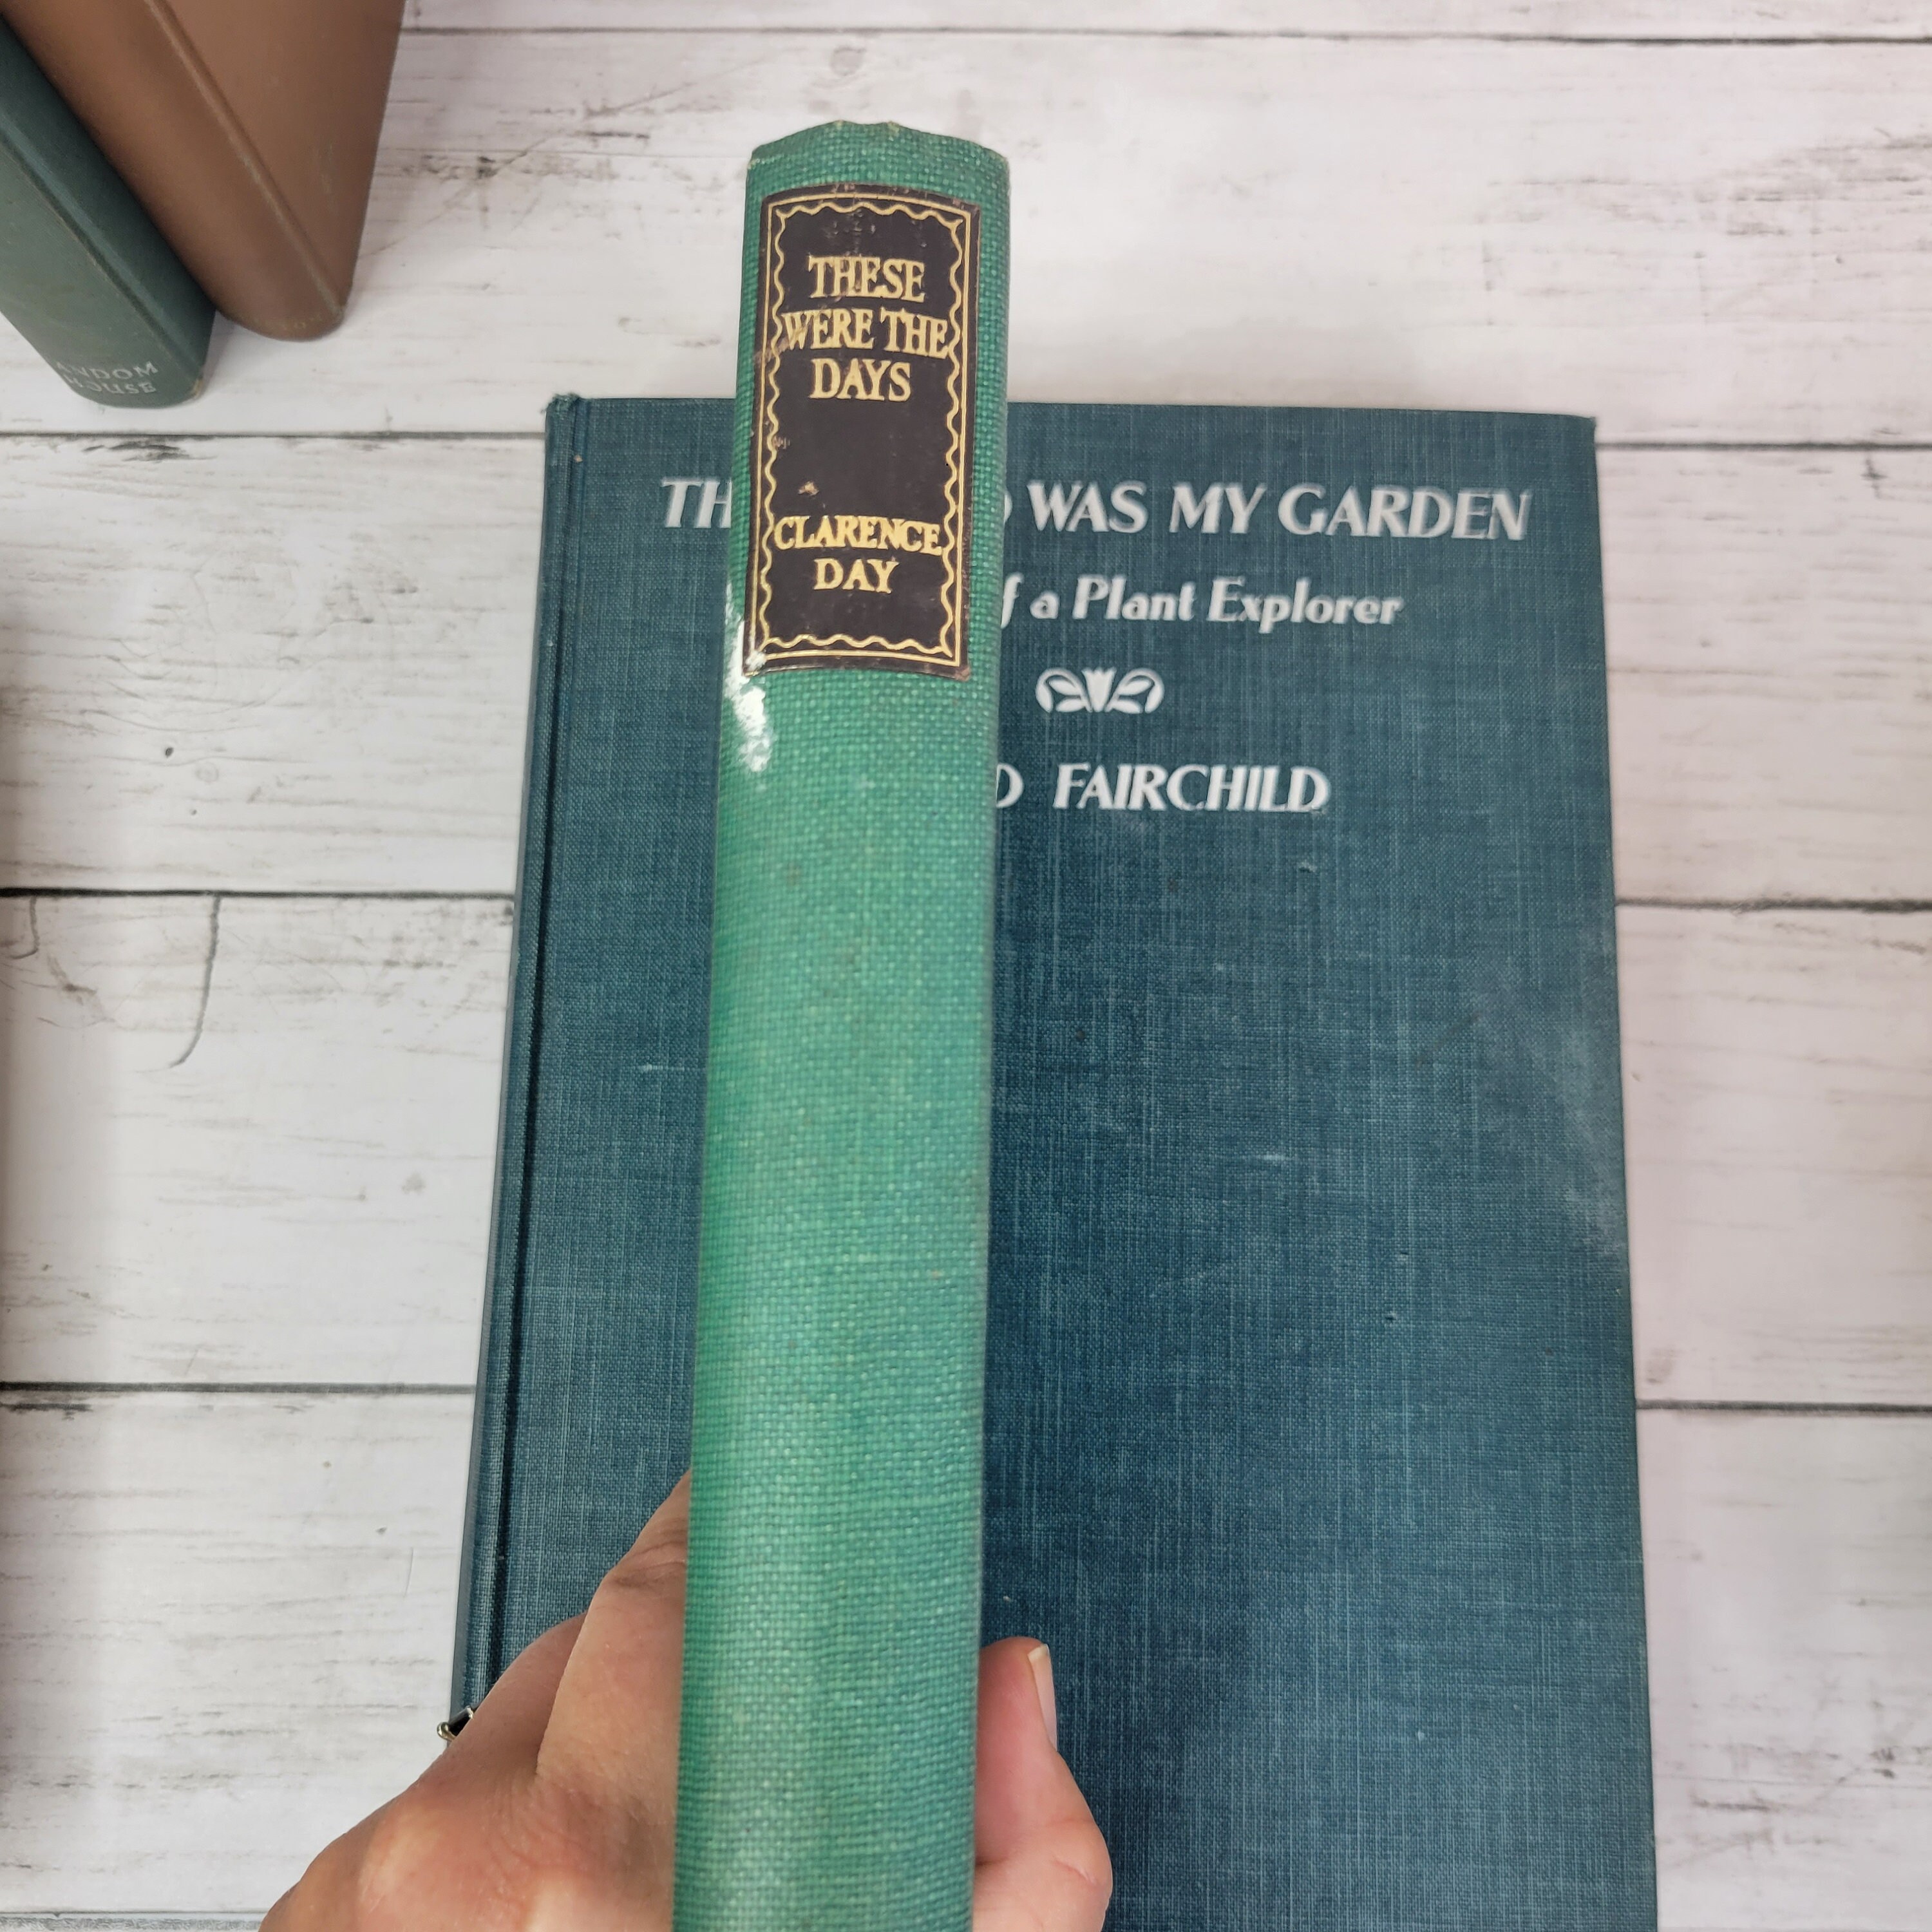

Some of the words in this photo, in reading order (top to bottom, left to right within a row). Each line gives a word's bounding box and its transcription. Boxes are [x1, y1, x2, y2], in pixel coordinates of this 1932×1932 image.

[808, 255, 925, 302] THESE
[781, 308, 874, 350] WERE
[880, 307, 949, 359] THE
[809, 359, 911, 401] DAYS
[662, 478, 732, 528] TH
[1027, 481, 1148, 533] WAS
[1170, 483, 1265, 534] MY
[1278, 485, 1531, 541] GARDEN
[774, 515, 943, 556] CLARENCE
[813, 558, 900, 594] DAY
[1000, 573, 1024, 629] f
[1030, 592, 1059, 619] a
[1072, 574, 1195, 621] Plant
[1207, 576, 1404, 633] Explorer
[1054, 764, 1331, 813] FAIRCHILD
